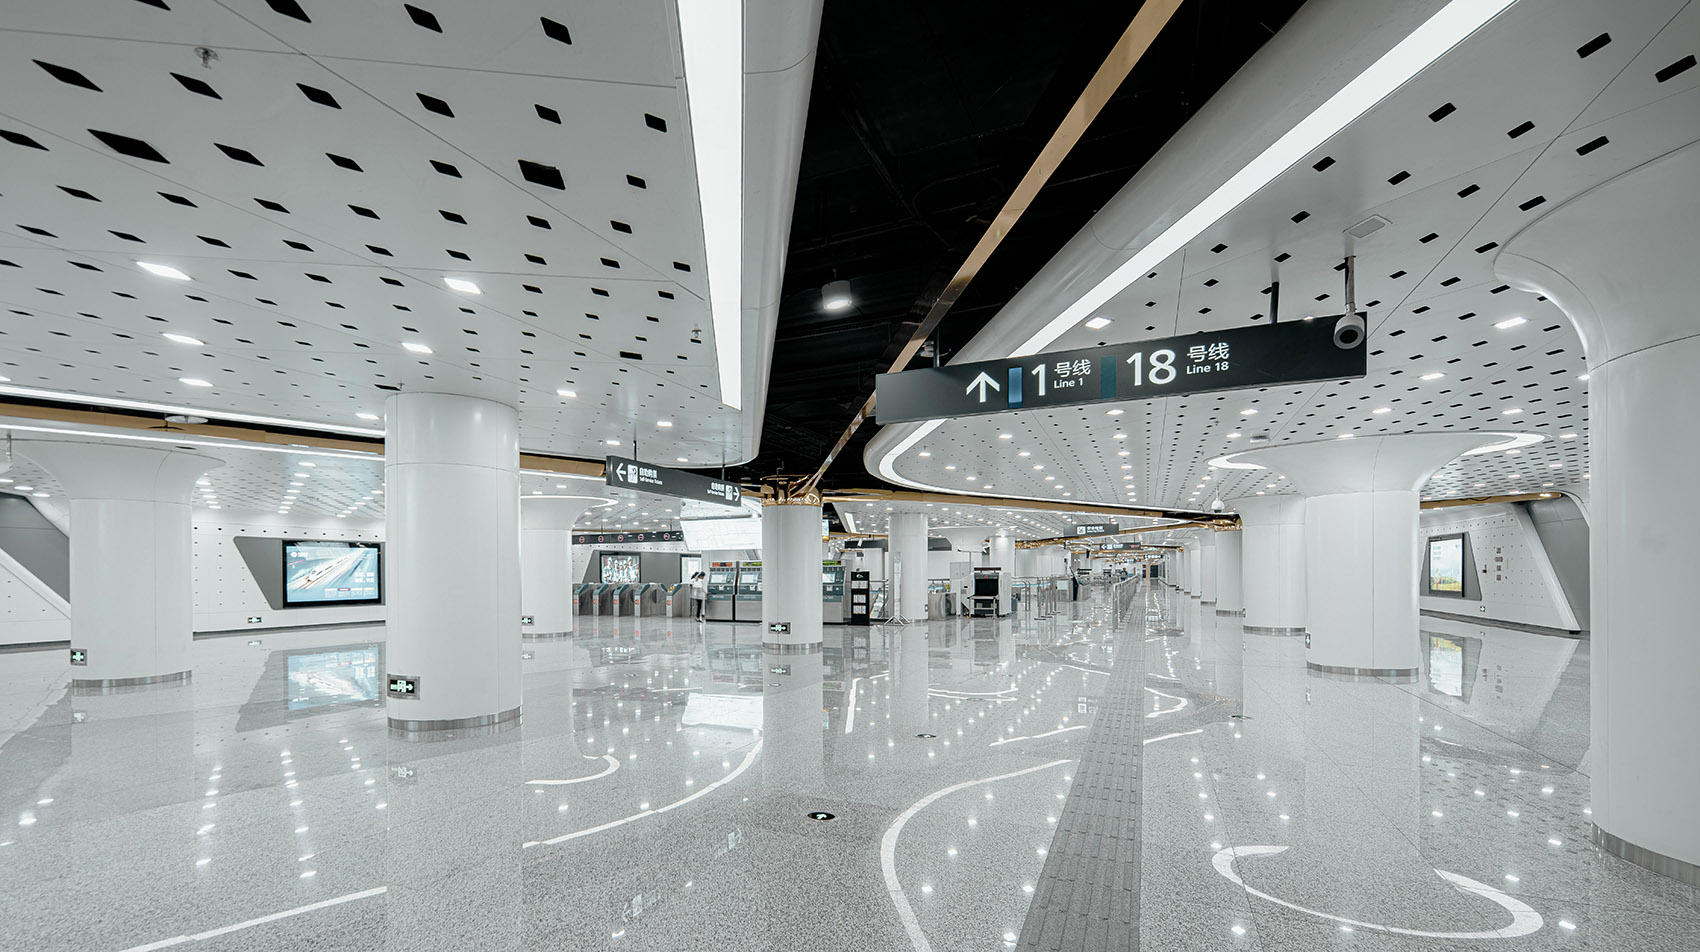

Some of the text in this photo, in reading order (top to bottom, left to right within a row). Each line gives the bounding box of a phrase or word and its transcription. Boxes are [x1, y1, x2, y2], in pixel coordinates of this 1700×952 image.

[1126, 342, 1230, 386] 18 号线
[1186, 361, 1230, 375] Line 18
[1031, 359, 1091, 397] 1 号线
[1053, 377, 1084, 389] Line 1
